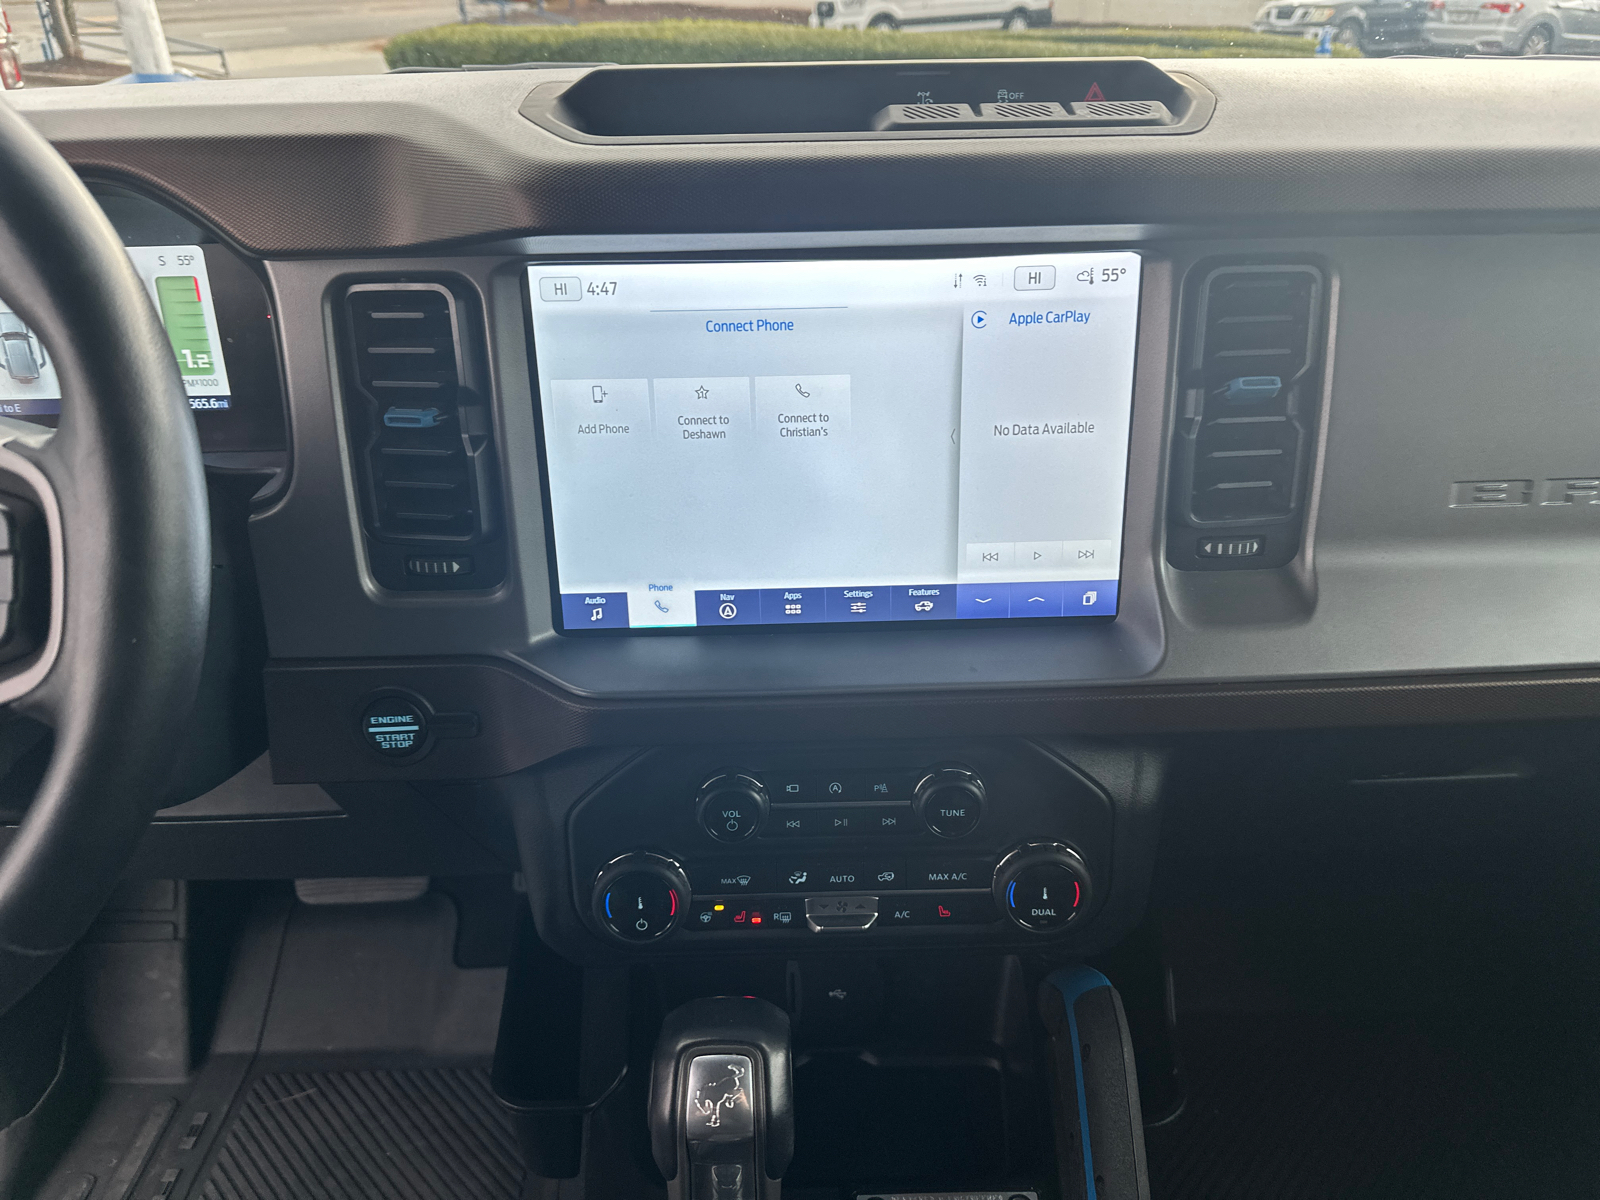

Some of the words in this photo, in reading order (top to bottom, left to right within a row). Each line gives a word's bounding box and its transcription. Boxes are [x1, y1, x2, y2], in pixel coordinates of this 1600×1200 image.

[158, 255, 166, 266] S
[1027, 271, 1042, 285] HI
[1101, 267, 1127, 283] 55°
[553, 282, 569, 296] HI
[586, 281, 618, 296] 4:47
[1009, 311, 1044, 327] Apple
[1045, 310, 1091, 325] CarPlay
[705, 319, 754, 333] Connect
[756, 318, 794, 332] Phone
[180, 349, 211, 369] 1.2
[3, 403, 14, 413] to
[14, 403, 22, 413] E
[677, 415, 716, 426] Connect
[717, 415, 730, 425] to
[777, 412, 816, 424] Connect
[818, 412, 830, 423] to
[577, 424, 598, 435] Add
[599, 423, 630, 435] Phone
[779, 426, 829, 437] Christian's
[993, 423, 1010, 436] No
[1012, 423, 1040, 436] Data
[1042, 421, 1095, 435] Available
[682, 428, 726, 440] Deshawn
[648, 583, 673, 592] Phone
[908, 588, 940, 597] Features
[719, 593, 736, 601] Nav
[783, 591, 803, 601] Apps
[843, 589, 874, 599] Settings
[584, 596, 607, 605] Audio
[370, 715, 414, 724] ENGINE
[375, 733, 415, 742] START
[381, 740, 413, 748] STOP
[722, 810, 741, 818] VOL
[940, 809, 966, 818] TUNE
[829, 875, 855, 883] AUTO
[928, 873, 950, 881] MAX
[951, 872, 967, 881] A/C
[894, 910, 910, 919] A/C
[1031, 908, 1056, 916] DUAL
